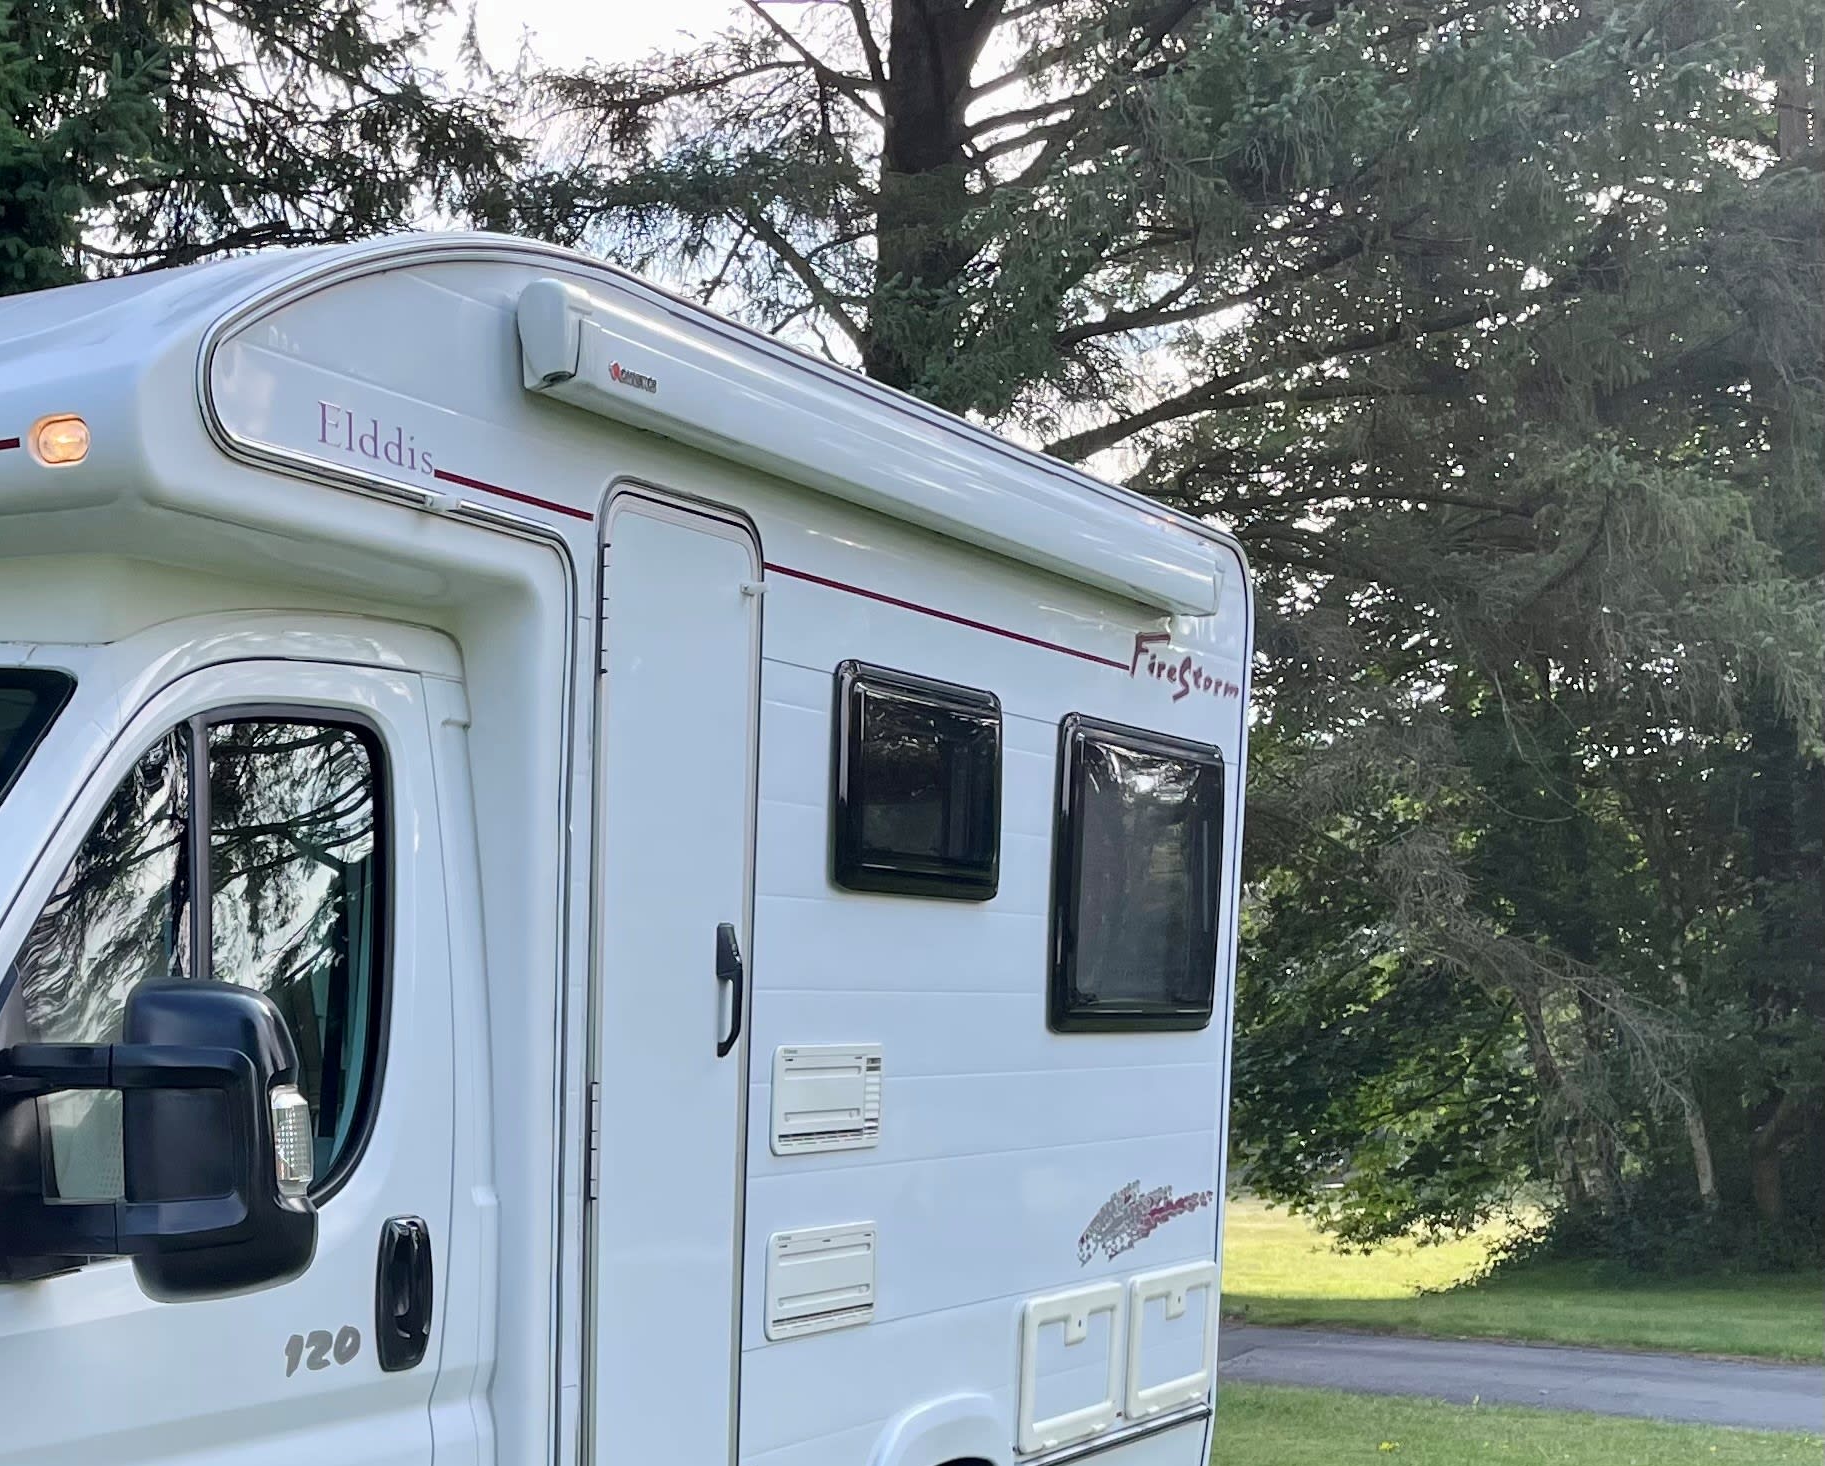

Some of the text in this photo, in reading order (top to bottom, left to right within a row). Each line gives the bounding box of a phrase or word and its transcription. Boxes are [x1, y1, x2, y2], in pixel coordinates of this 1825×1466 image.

[317, 400, 435, 476] Elddis
[1130, 632, 1240, 703] FireStorm
[284, 1325, 361, 1377] 120
